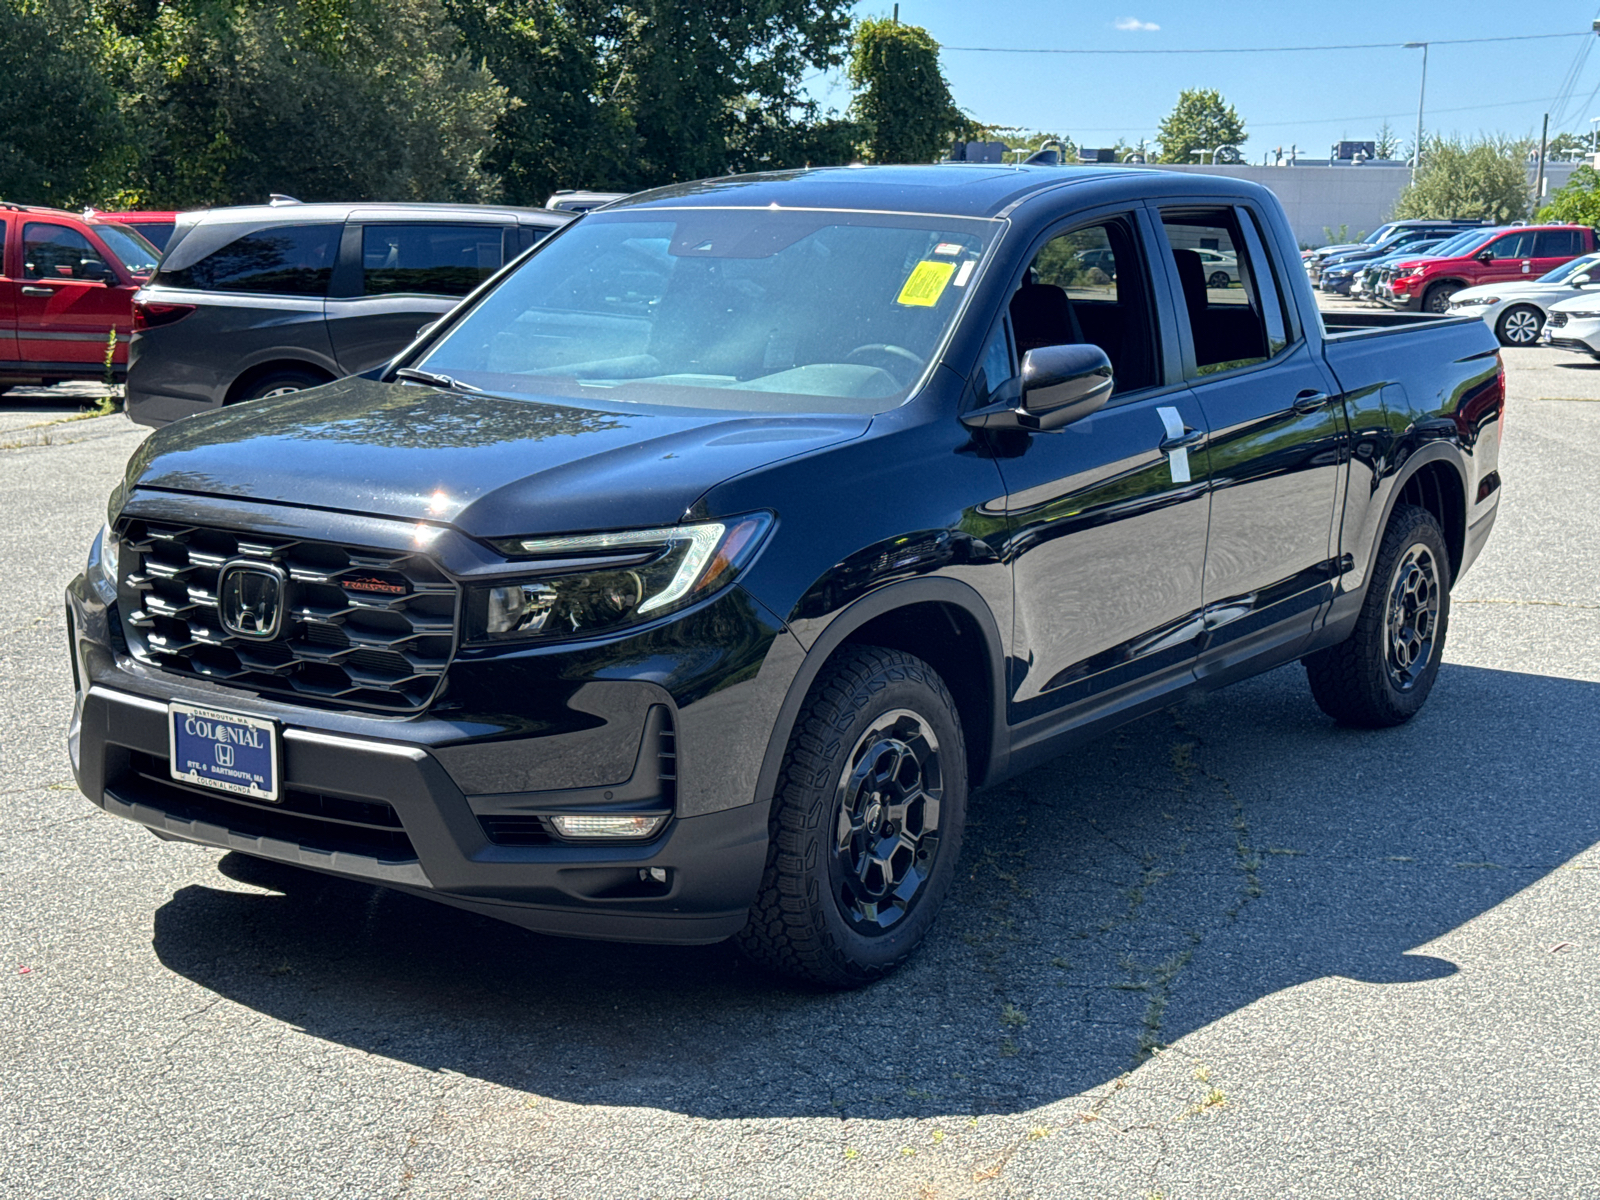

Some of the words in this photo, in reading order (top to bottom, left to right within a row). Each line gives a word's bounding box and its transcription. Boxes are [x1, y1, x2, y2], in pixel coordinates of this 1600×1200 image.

[342, 580, 403, 593] TRAILSPORT
[185, 719, 264, 749] COLONIAL
[196, 777, 227, 790] COLONIAL
[228, 784, 251, 794] HONDA
[253, 774, 264, 783] MA
